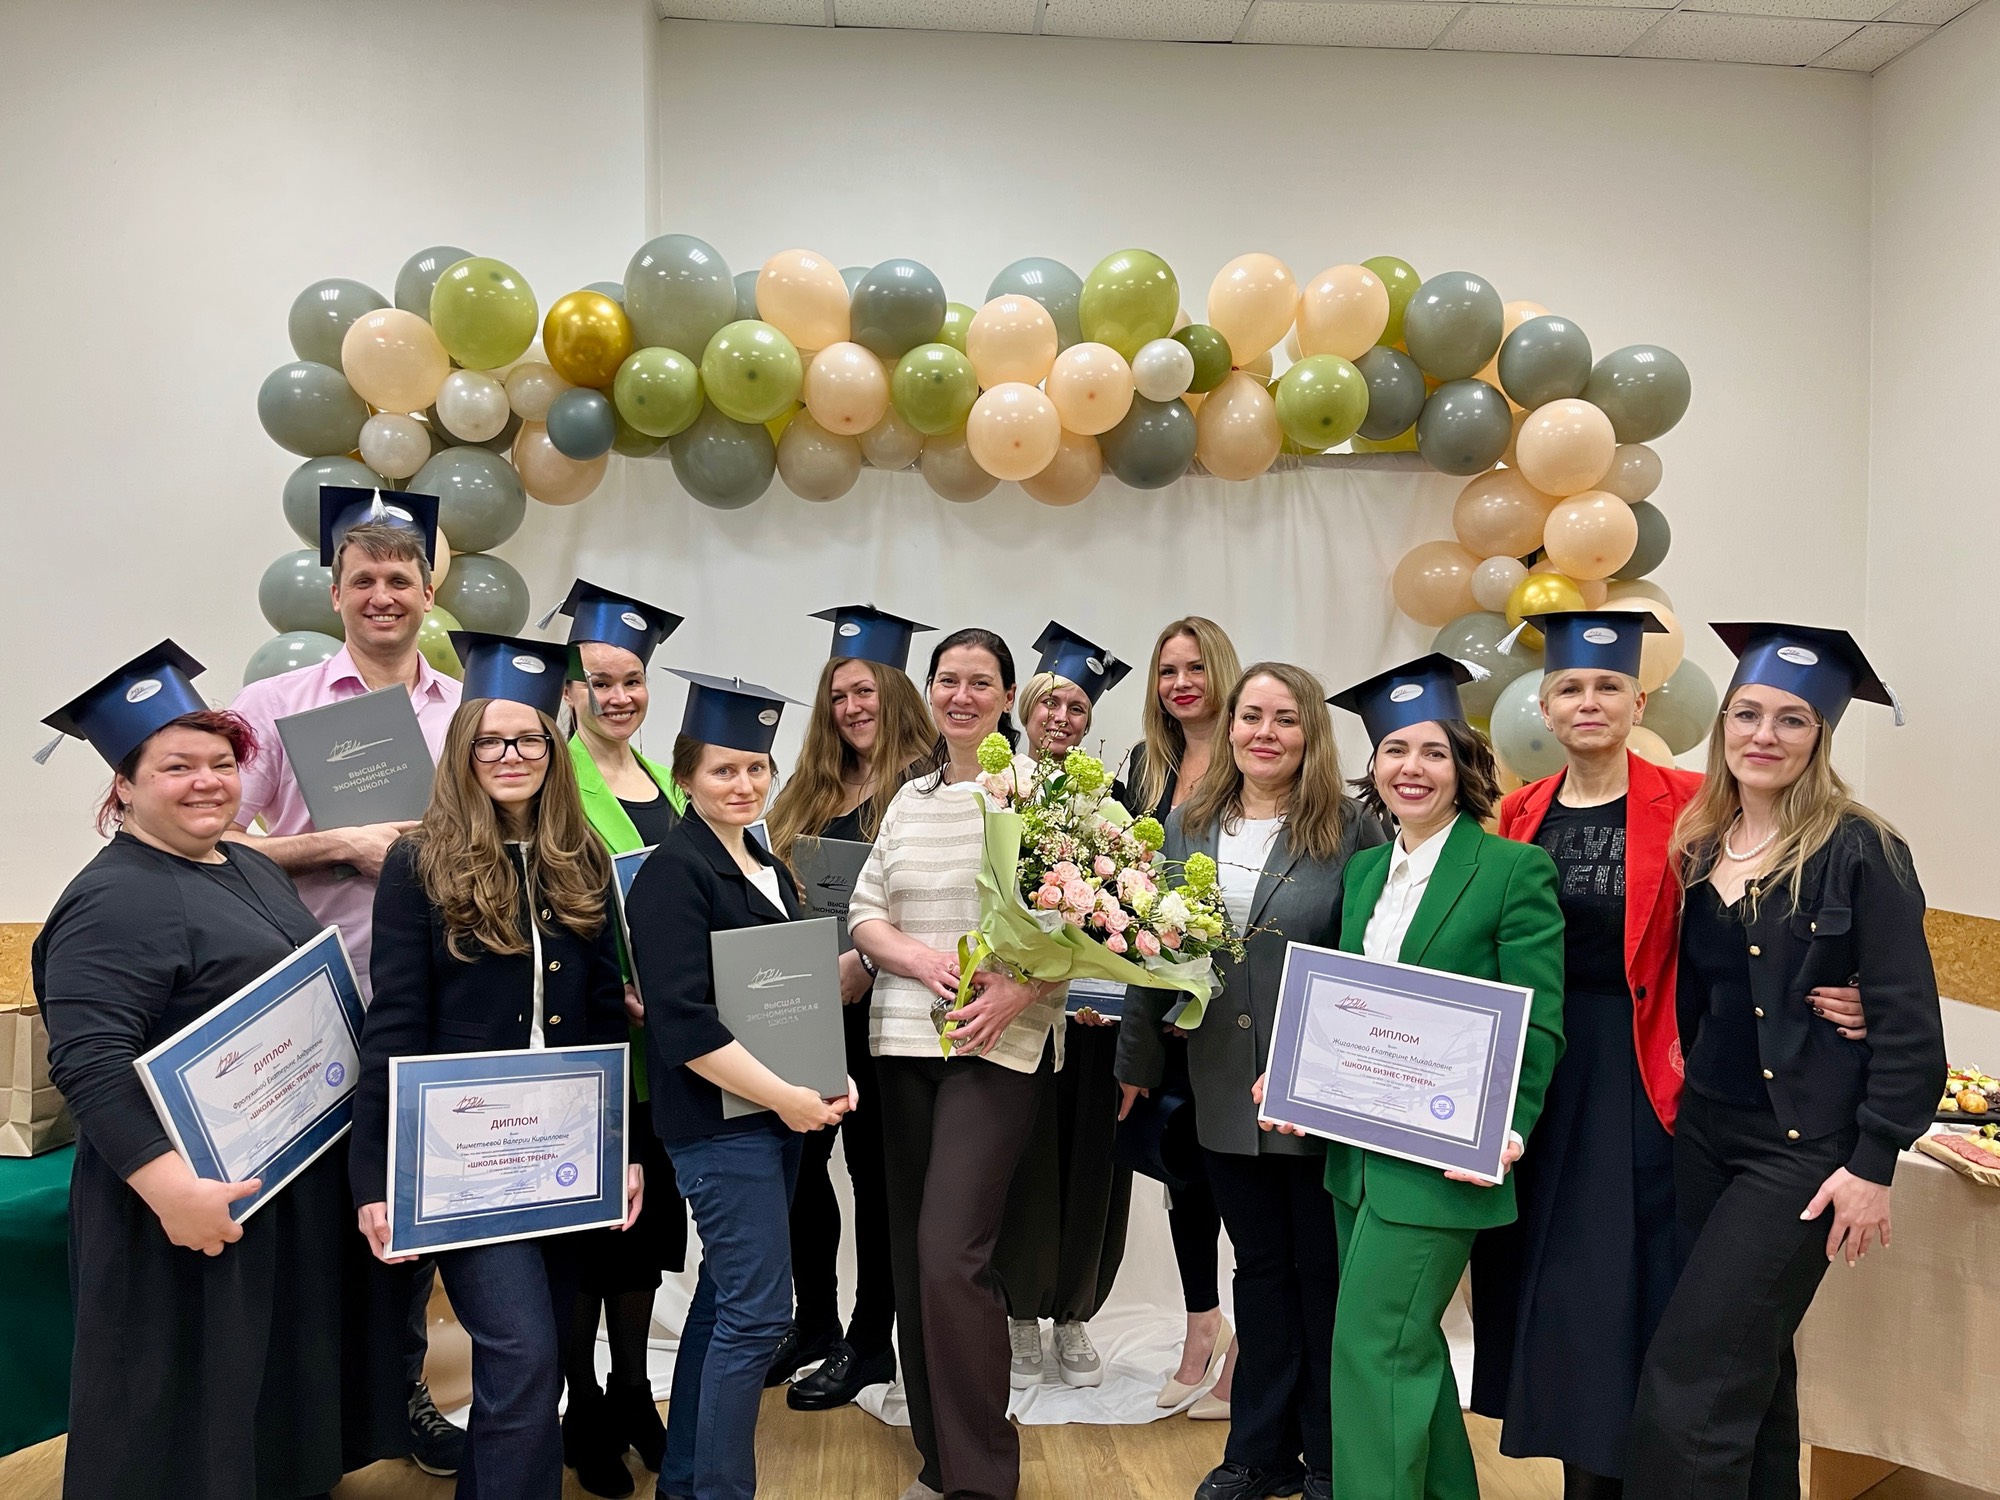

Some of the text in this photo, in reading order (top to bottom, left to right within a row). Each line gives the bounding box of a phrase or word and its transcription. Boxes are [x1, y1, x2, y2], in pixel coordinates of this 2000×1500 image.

[332, 763, 408, 793] ЭКОНОМИЧЕСКАЯ
[348, 761, 388, 779] ВЫСШАЯ
[357, 778, 390, 793] ШКОЛА
[812, 905, 849, 915] ЭКОНОМИ
[827, 901, 849, 909] ВЫСШ
[746, 1003, 819, 1022] ЭКОНОМИЧЕСКАЯ
[763, 997, 801, 1010] ВЫСШАЯ
[1369, 1026, 1420, 1046] ДИПЛОМ
[253, 1038, 293, 1075] ДИПЛОМ
[1371, 1046, 1408, 1060] Екатерине
[1410, 1056, 1453, 1071] Михайловне
[1342, 1060, 1372, 1073] «ШКОЛА
[1373, 1067, 1436, 1088] БИЗНЕС-ТРЕНЕРА»
[250, 1098, 275, 1120] «ШКОЛА
[274, 1062, 322, 1101] БИЗНЕС-ТРЕНЕРА»
[490, 1116, 538, 1131] ДИПЛОМ
[503, 1137, 531, 1147] Валерии
[532, 1133, 570, 1144] Кирилловне
[467, 1160, 498, 1169] «ШКОЛА
[499, 1153, 559, 1165] БИЗНЕС-ТРЕНЕРА»
